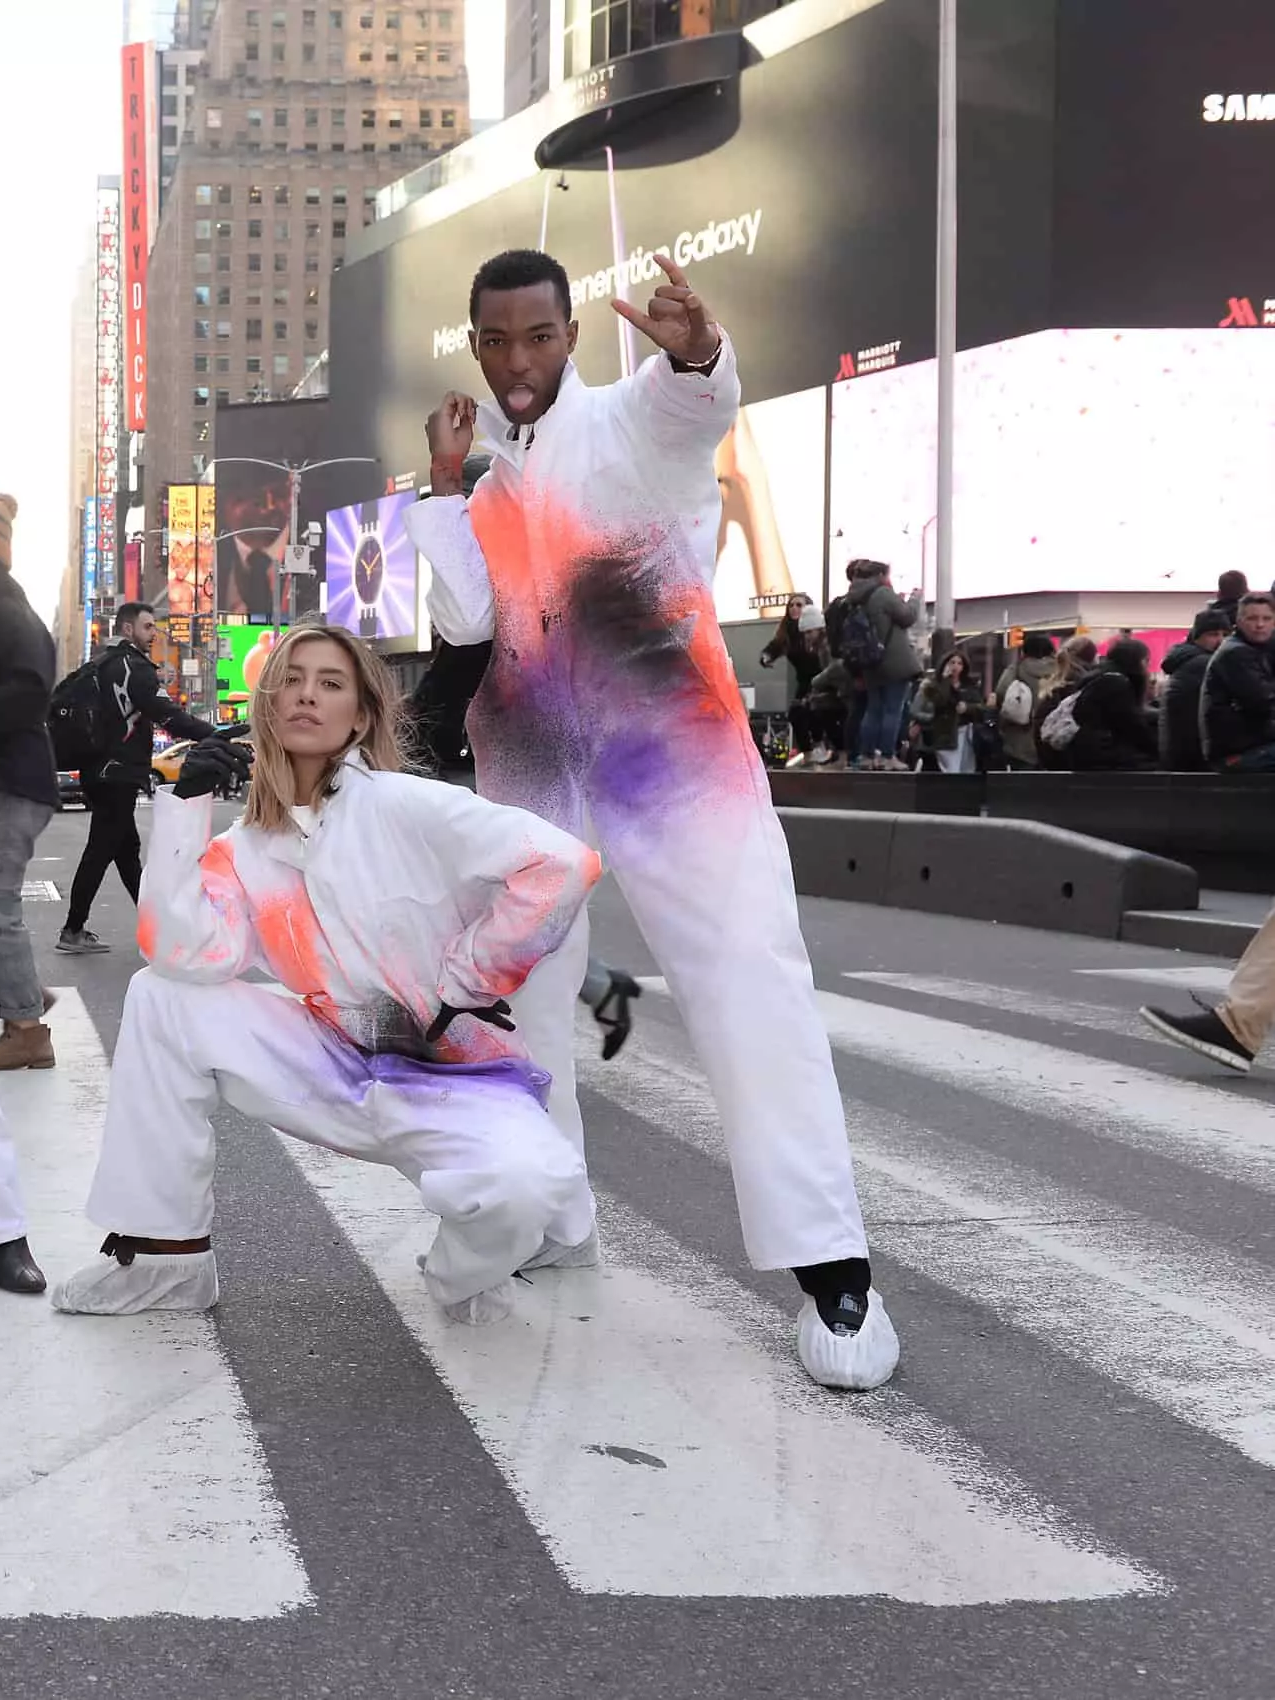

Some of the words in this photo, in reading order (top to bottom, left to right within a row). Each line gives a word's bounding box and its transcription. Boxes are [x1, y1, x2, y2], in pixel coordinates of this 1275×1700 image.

[128, 56, 141, 271] TRICKY
[674, 209, 762, 267] Galaxy
[133, 282, 145, 421] DICK
